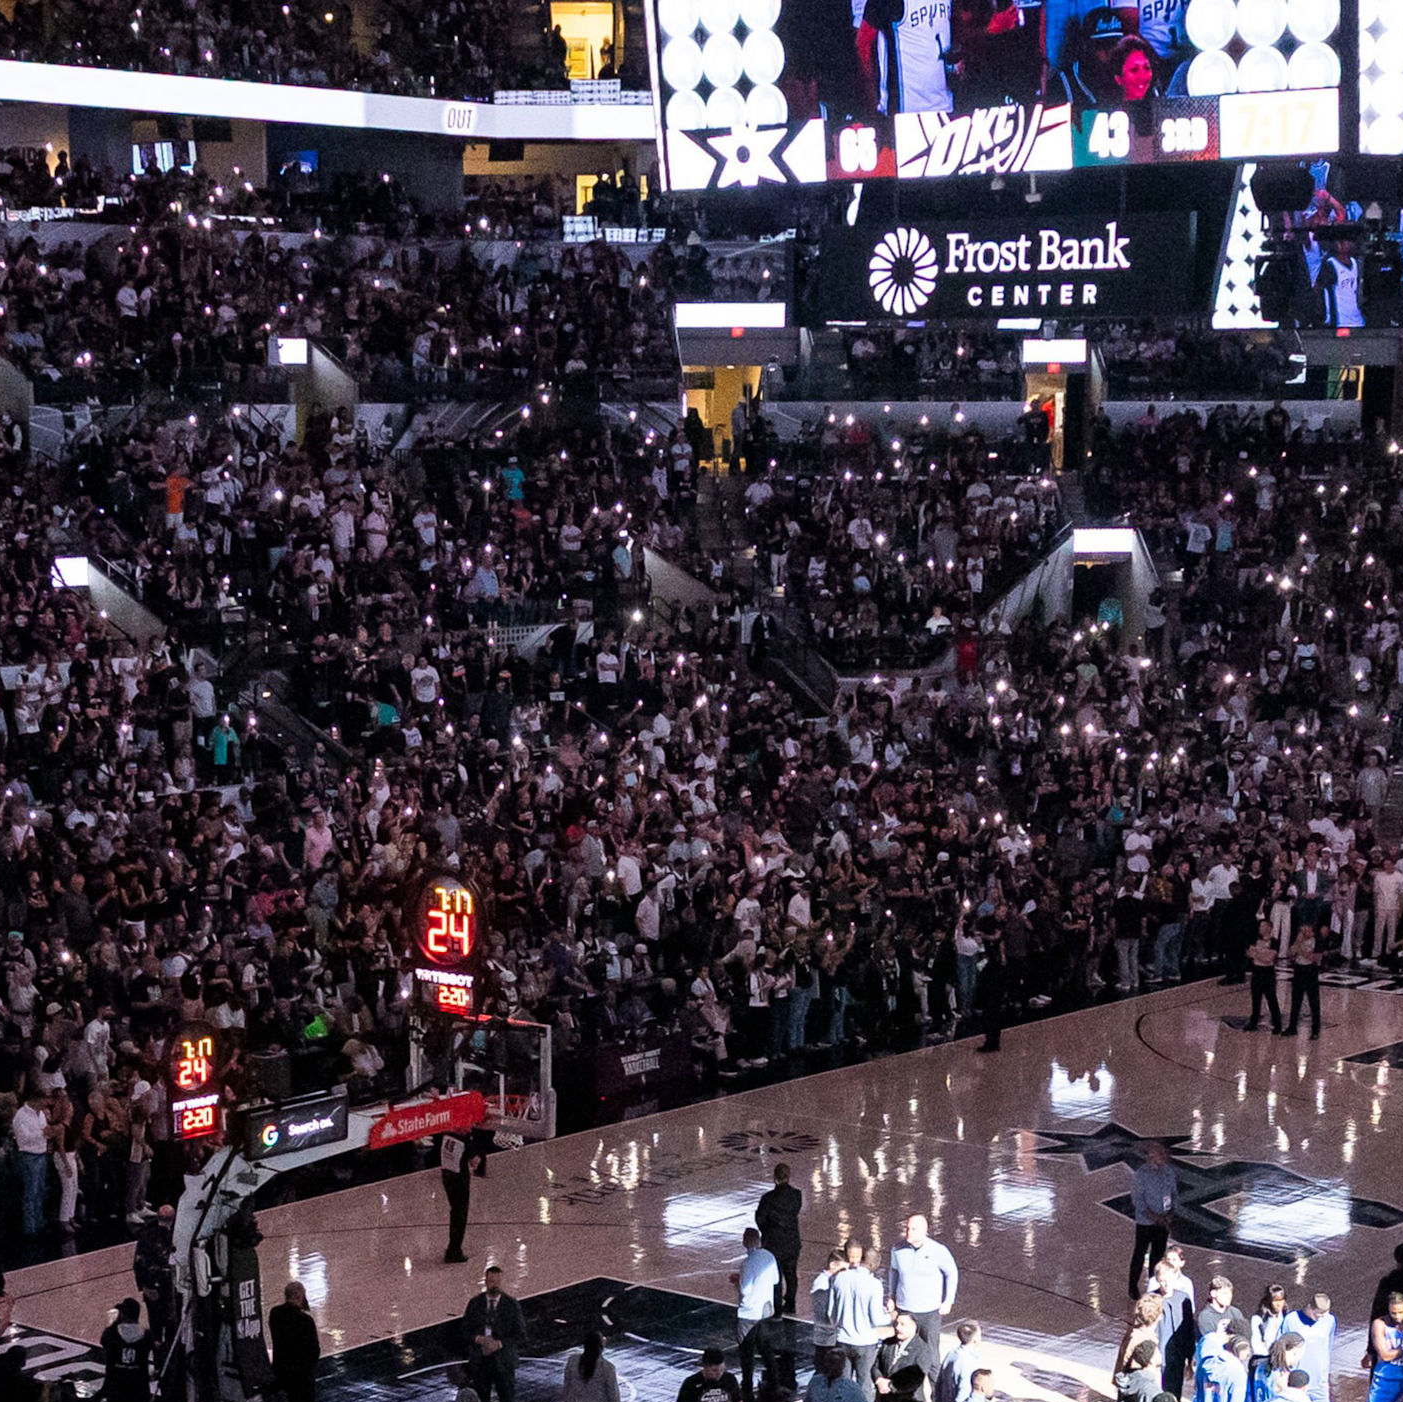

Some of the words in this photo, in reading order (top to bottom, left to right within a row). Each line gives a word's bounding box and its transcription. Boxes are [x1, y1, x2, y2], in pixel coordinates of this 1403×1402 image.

[447, 107, 473, 129] OUT
[1088, 110, 1132, 158] 43
[945, 233, 1031, 273] Frost
[1037, 221, 1131, 271] Bank
[967, 284, 1097, 307] CENTER
[427, 909, 470, 955] 24
[179, 1058, 207, 1086] 24
